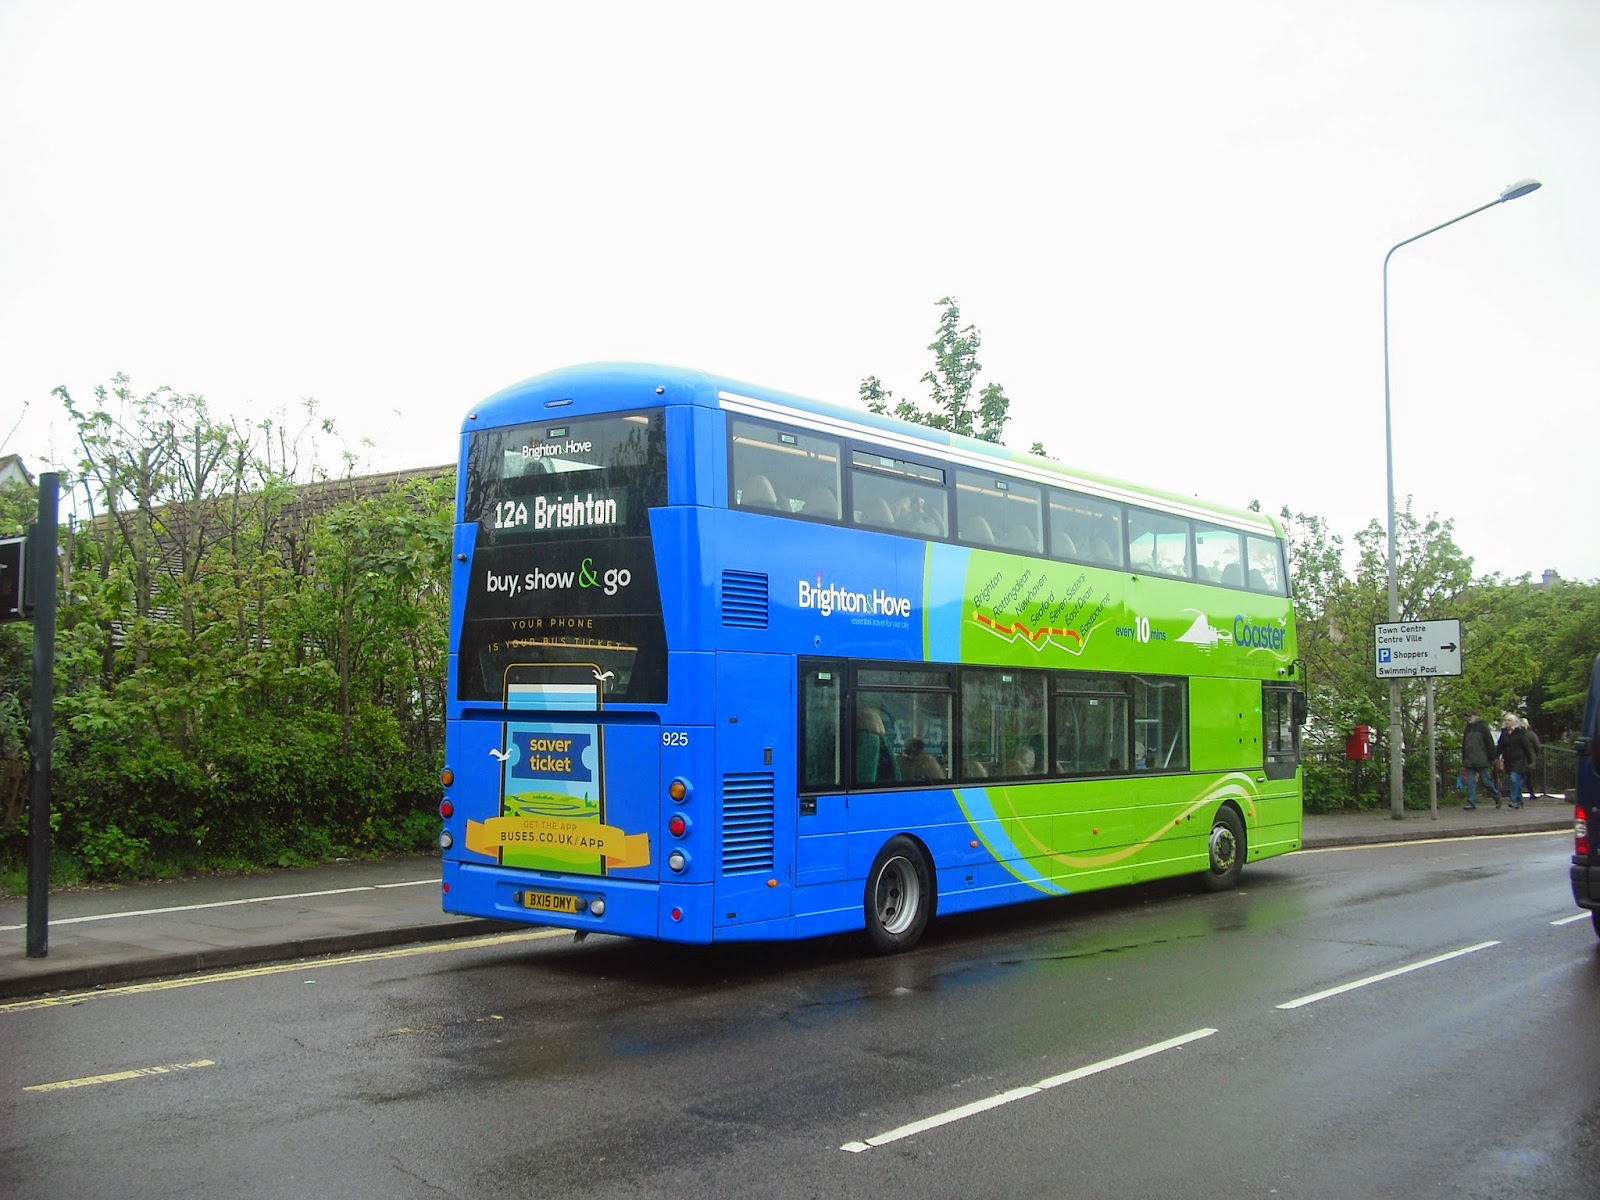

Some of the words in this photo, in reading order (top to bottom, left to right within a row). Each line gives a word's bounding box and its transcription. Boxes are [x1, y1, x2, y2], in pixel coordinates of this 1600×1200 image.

[494, 501, 528, 529] 12A
[534, 493, 617, 530] Brighton
[486, 570, 521, 597] buy,
[524, 567, 575, 589] show
[578, 557, 601, 588] &
[603, 568, 632, 596] go
[973, 571, 1003, 608] Brighton
[992, 569, 1032, 619] Rottingdean
[1014, 573, 1048, 616] Newhaven
[1049, 598, 1068, 623] Seven
[1066, 573, 1086, 601] Sisters
[1030, 590, 1056, 627] Seaford
[1065, 606, 1079, 626] East
[1077, 586, 1094, 610] Dean
[1079, 592, 1111, 636] Eastbourne
[511, 619, 543, 630] YOUR
[550, 618, 593, 629] PHONE
[1115, 626, 1135, 641] every
[1135, 616, 1150, 644] 10
[1150, 630, 1167, 641] mins
[1233, 615, 1286, 650] Coaster
[1400, 625, 1426, 633] Centre
[488, 642, 499, 652] IS
[505, 637, 536, 649] YOUR
[543, 637, 566, 647] BUS
[1377, 636, 1403, 644] Centre
[1406, 634, 1422, 642] Ville
[1380, 649, 1390, 662] P
[1393, 651, 1428, 660] Shoppers
[1378, 667, 1417, 675] Swimming
[1420, 665, 1437, 673] Pool
[529, 737, 572, 752] saver
[662, 731, 689, 746] 925
[529, 755, 572, 772] ticket
[523, 820, 539, 829] GET
[541, 820, 557, 830] THE
[560, 821, 577, 831] APP
[501, 831, 604, 849] BUSES.CO.UK/APP
[530, 893, 551, 907] BX15
[553, 896, 572, 910] OMY
